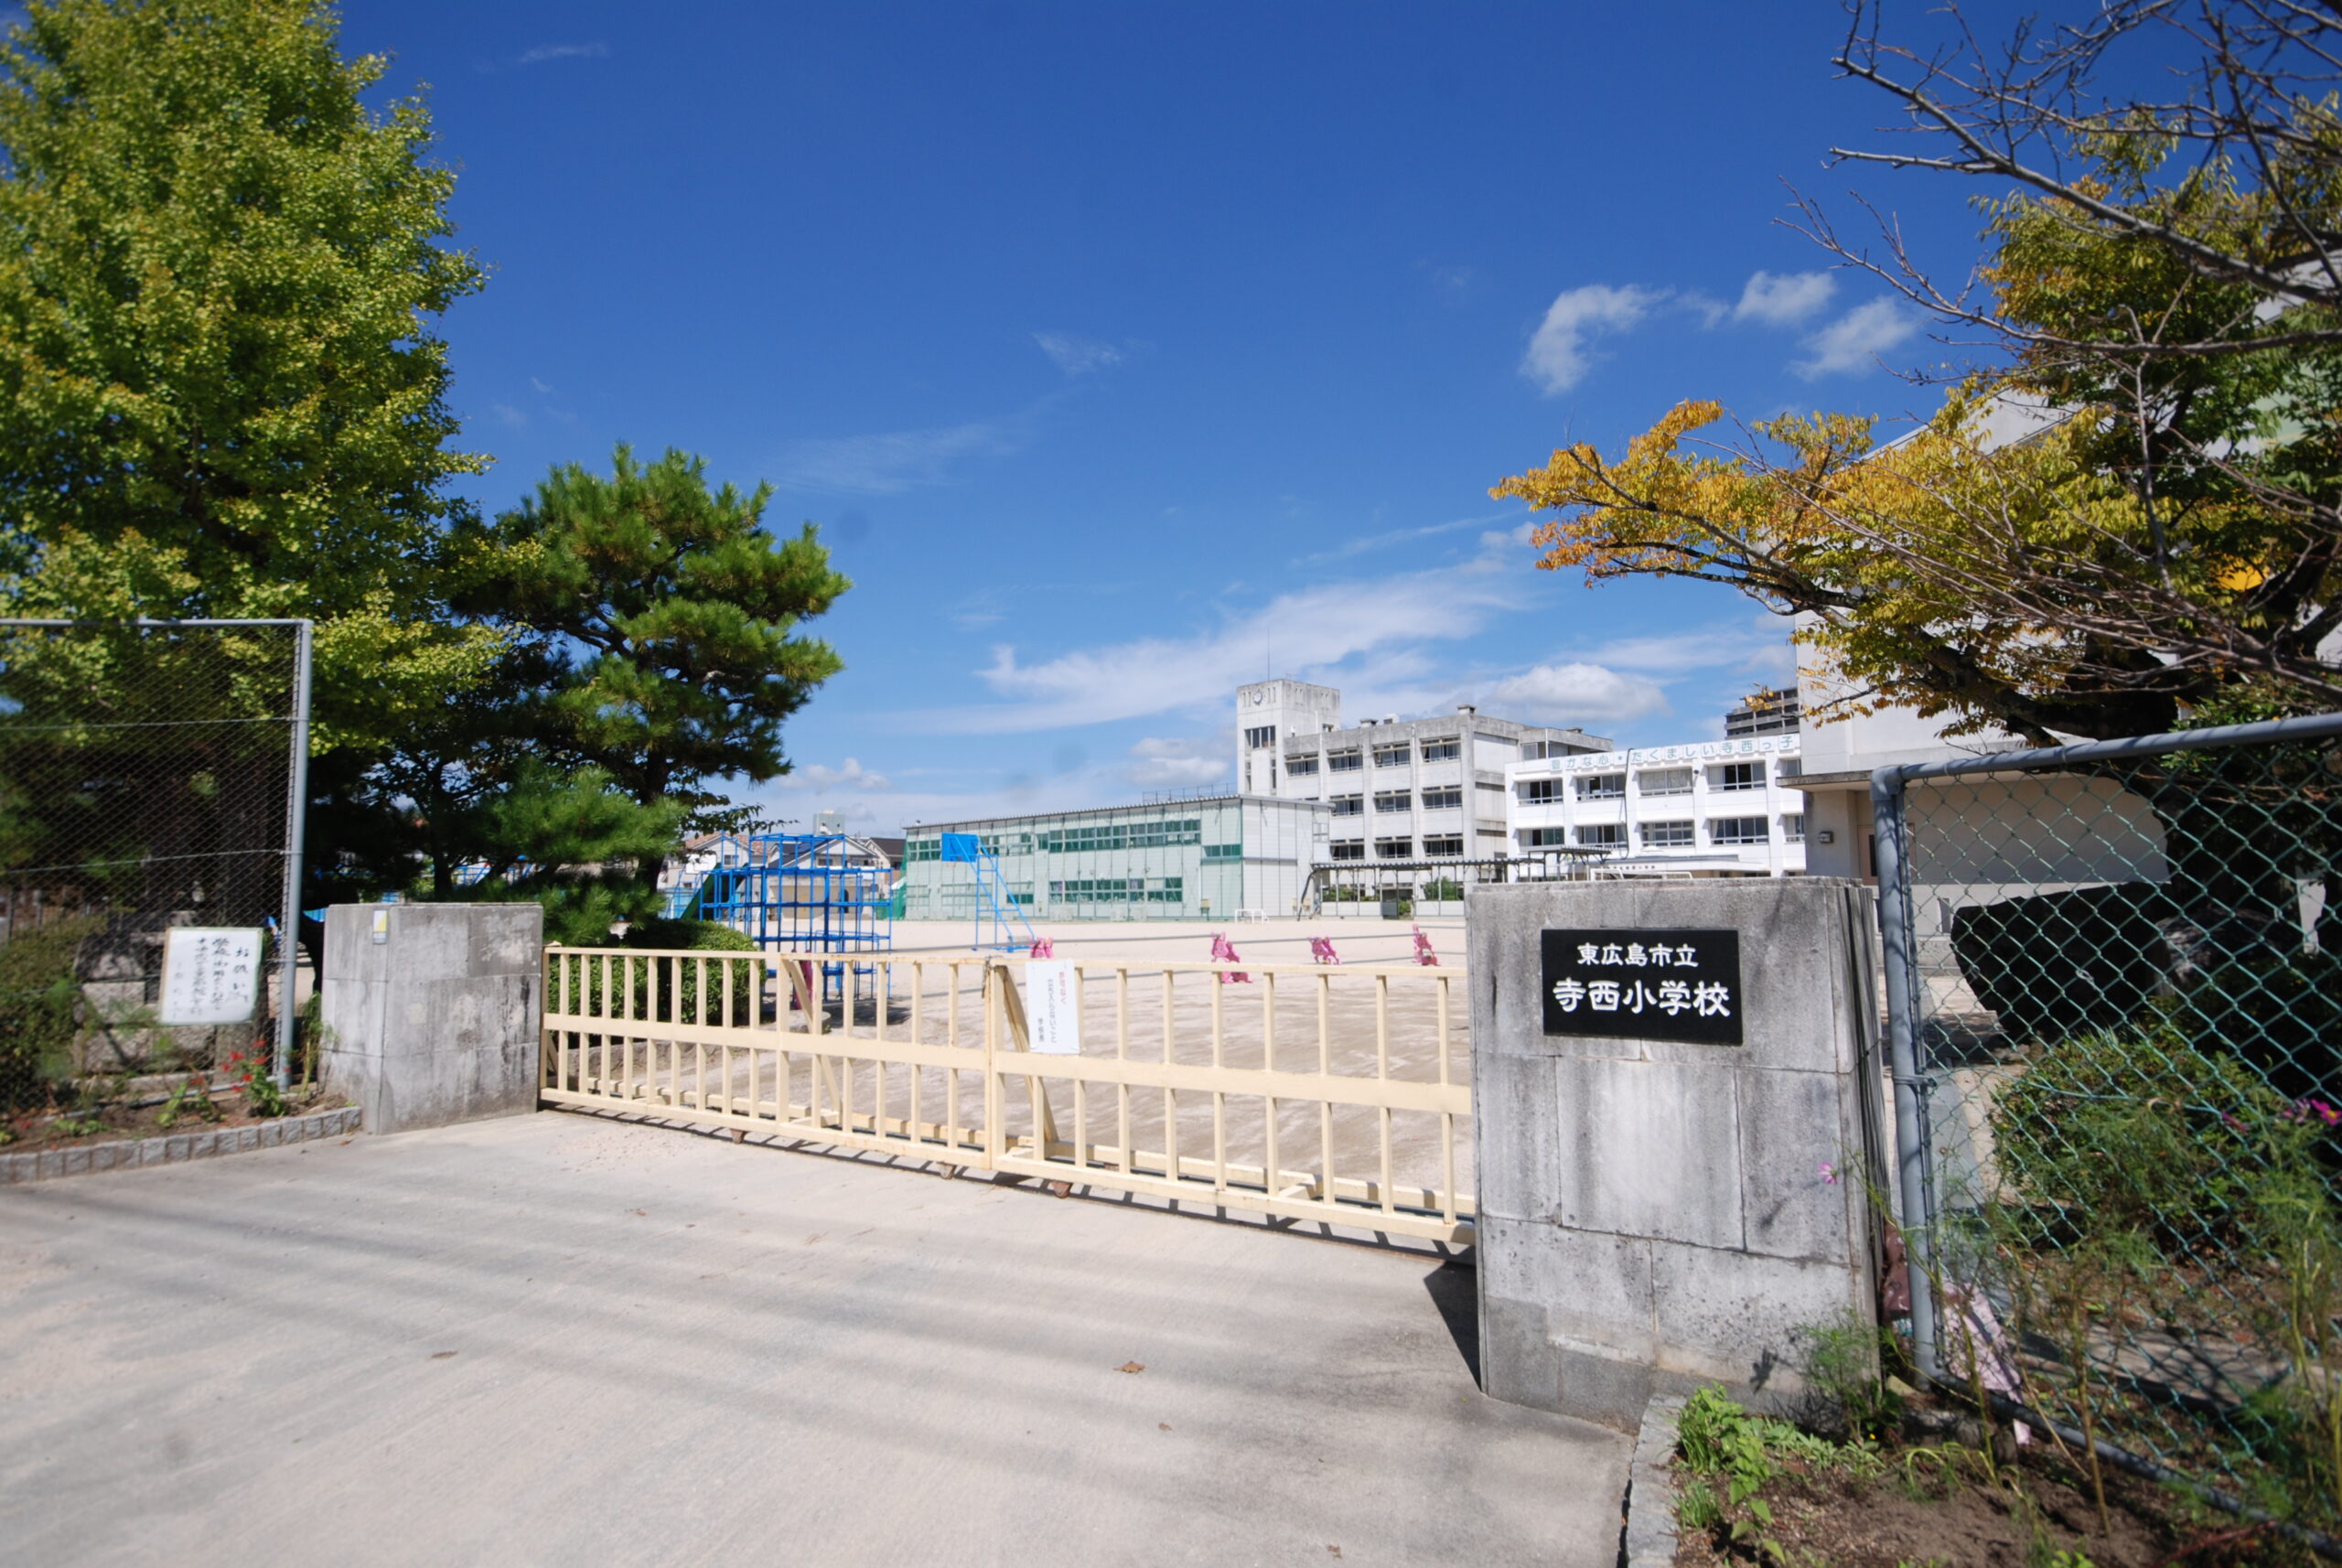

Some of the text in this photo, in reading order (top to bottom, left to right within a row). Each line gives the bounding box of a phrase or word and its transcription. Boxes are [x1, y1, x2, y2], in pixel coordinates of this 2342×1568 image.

[1576, 942, 1699, 967] 東広島市立
[1552, 976, 1731, 1017] 寺西小学校
